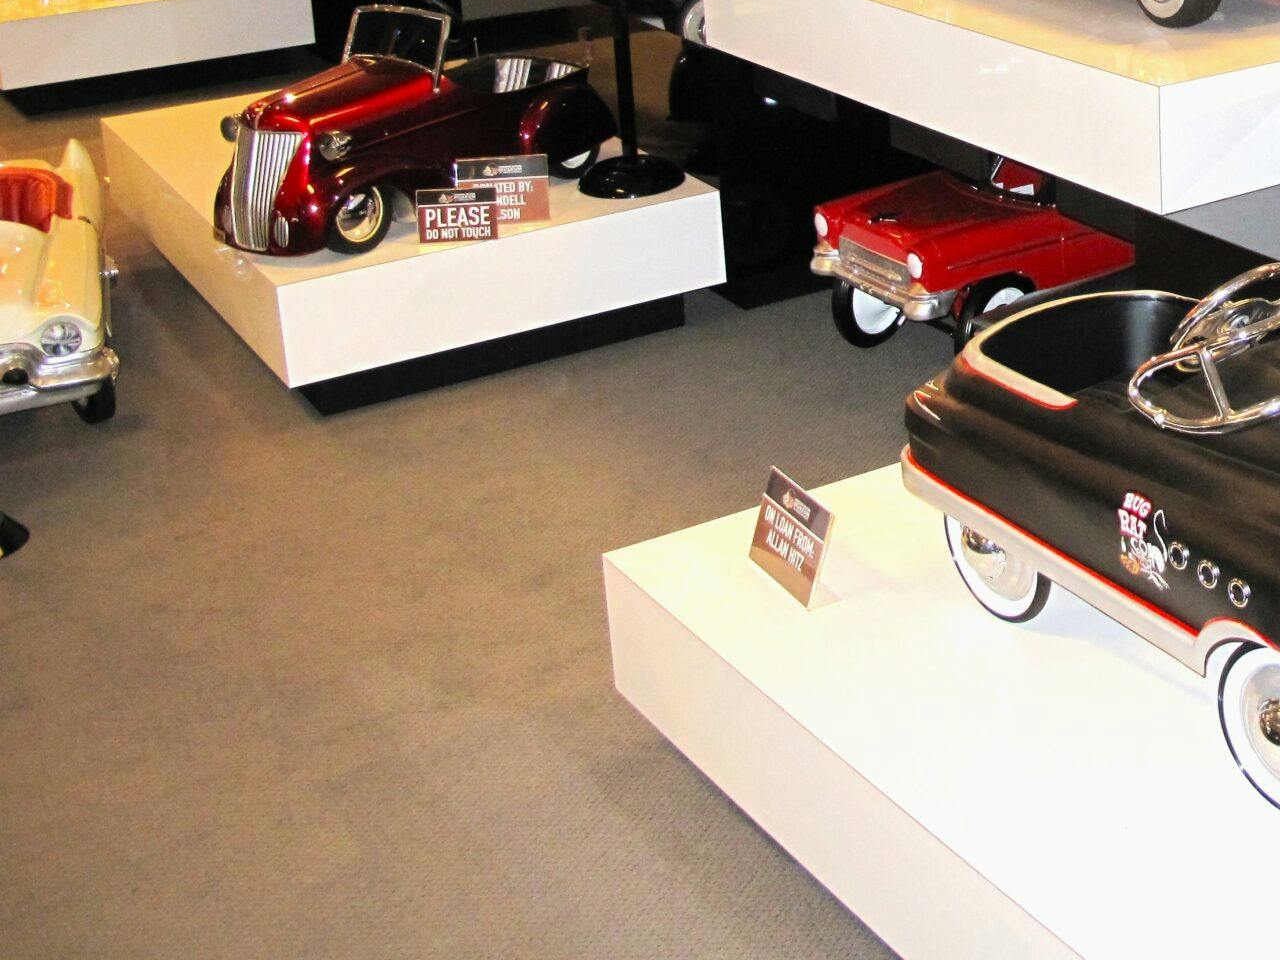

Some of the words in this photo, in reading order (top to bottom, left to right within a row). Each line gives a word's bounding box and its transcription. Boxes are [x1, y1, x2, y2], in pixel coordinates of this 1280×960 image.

[519, 180, 534, 192] BY:
[425, 206, 491, 228] PLEASE
[426, 229, 439, 240] DO
[441, 228, 459, 239] NOT
[461, 226, 491, 238] TOUCH
[1123, 492, 1152, 518] BUG
[764, 504, 776, 521] ON
[775, 512, 794, 539] LOAN
[793, 527, 815, 559] FROM:
[1118, 509, 1147, 539] RAT
[766, 528, 790, 559] ALLAN
[788, 547, 805, 572] HITZ
